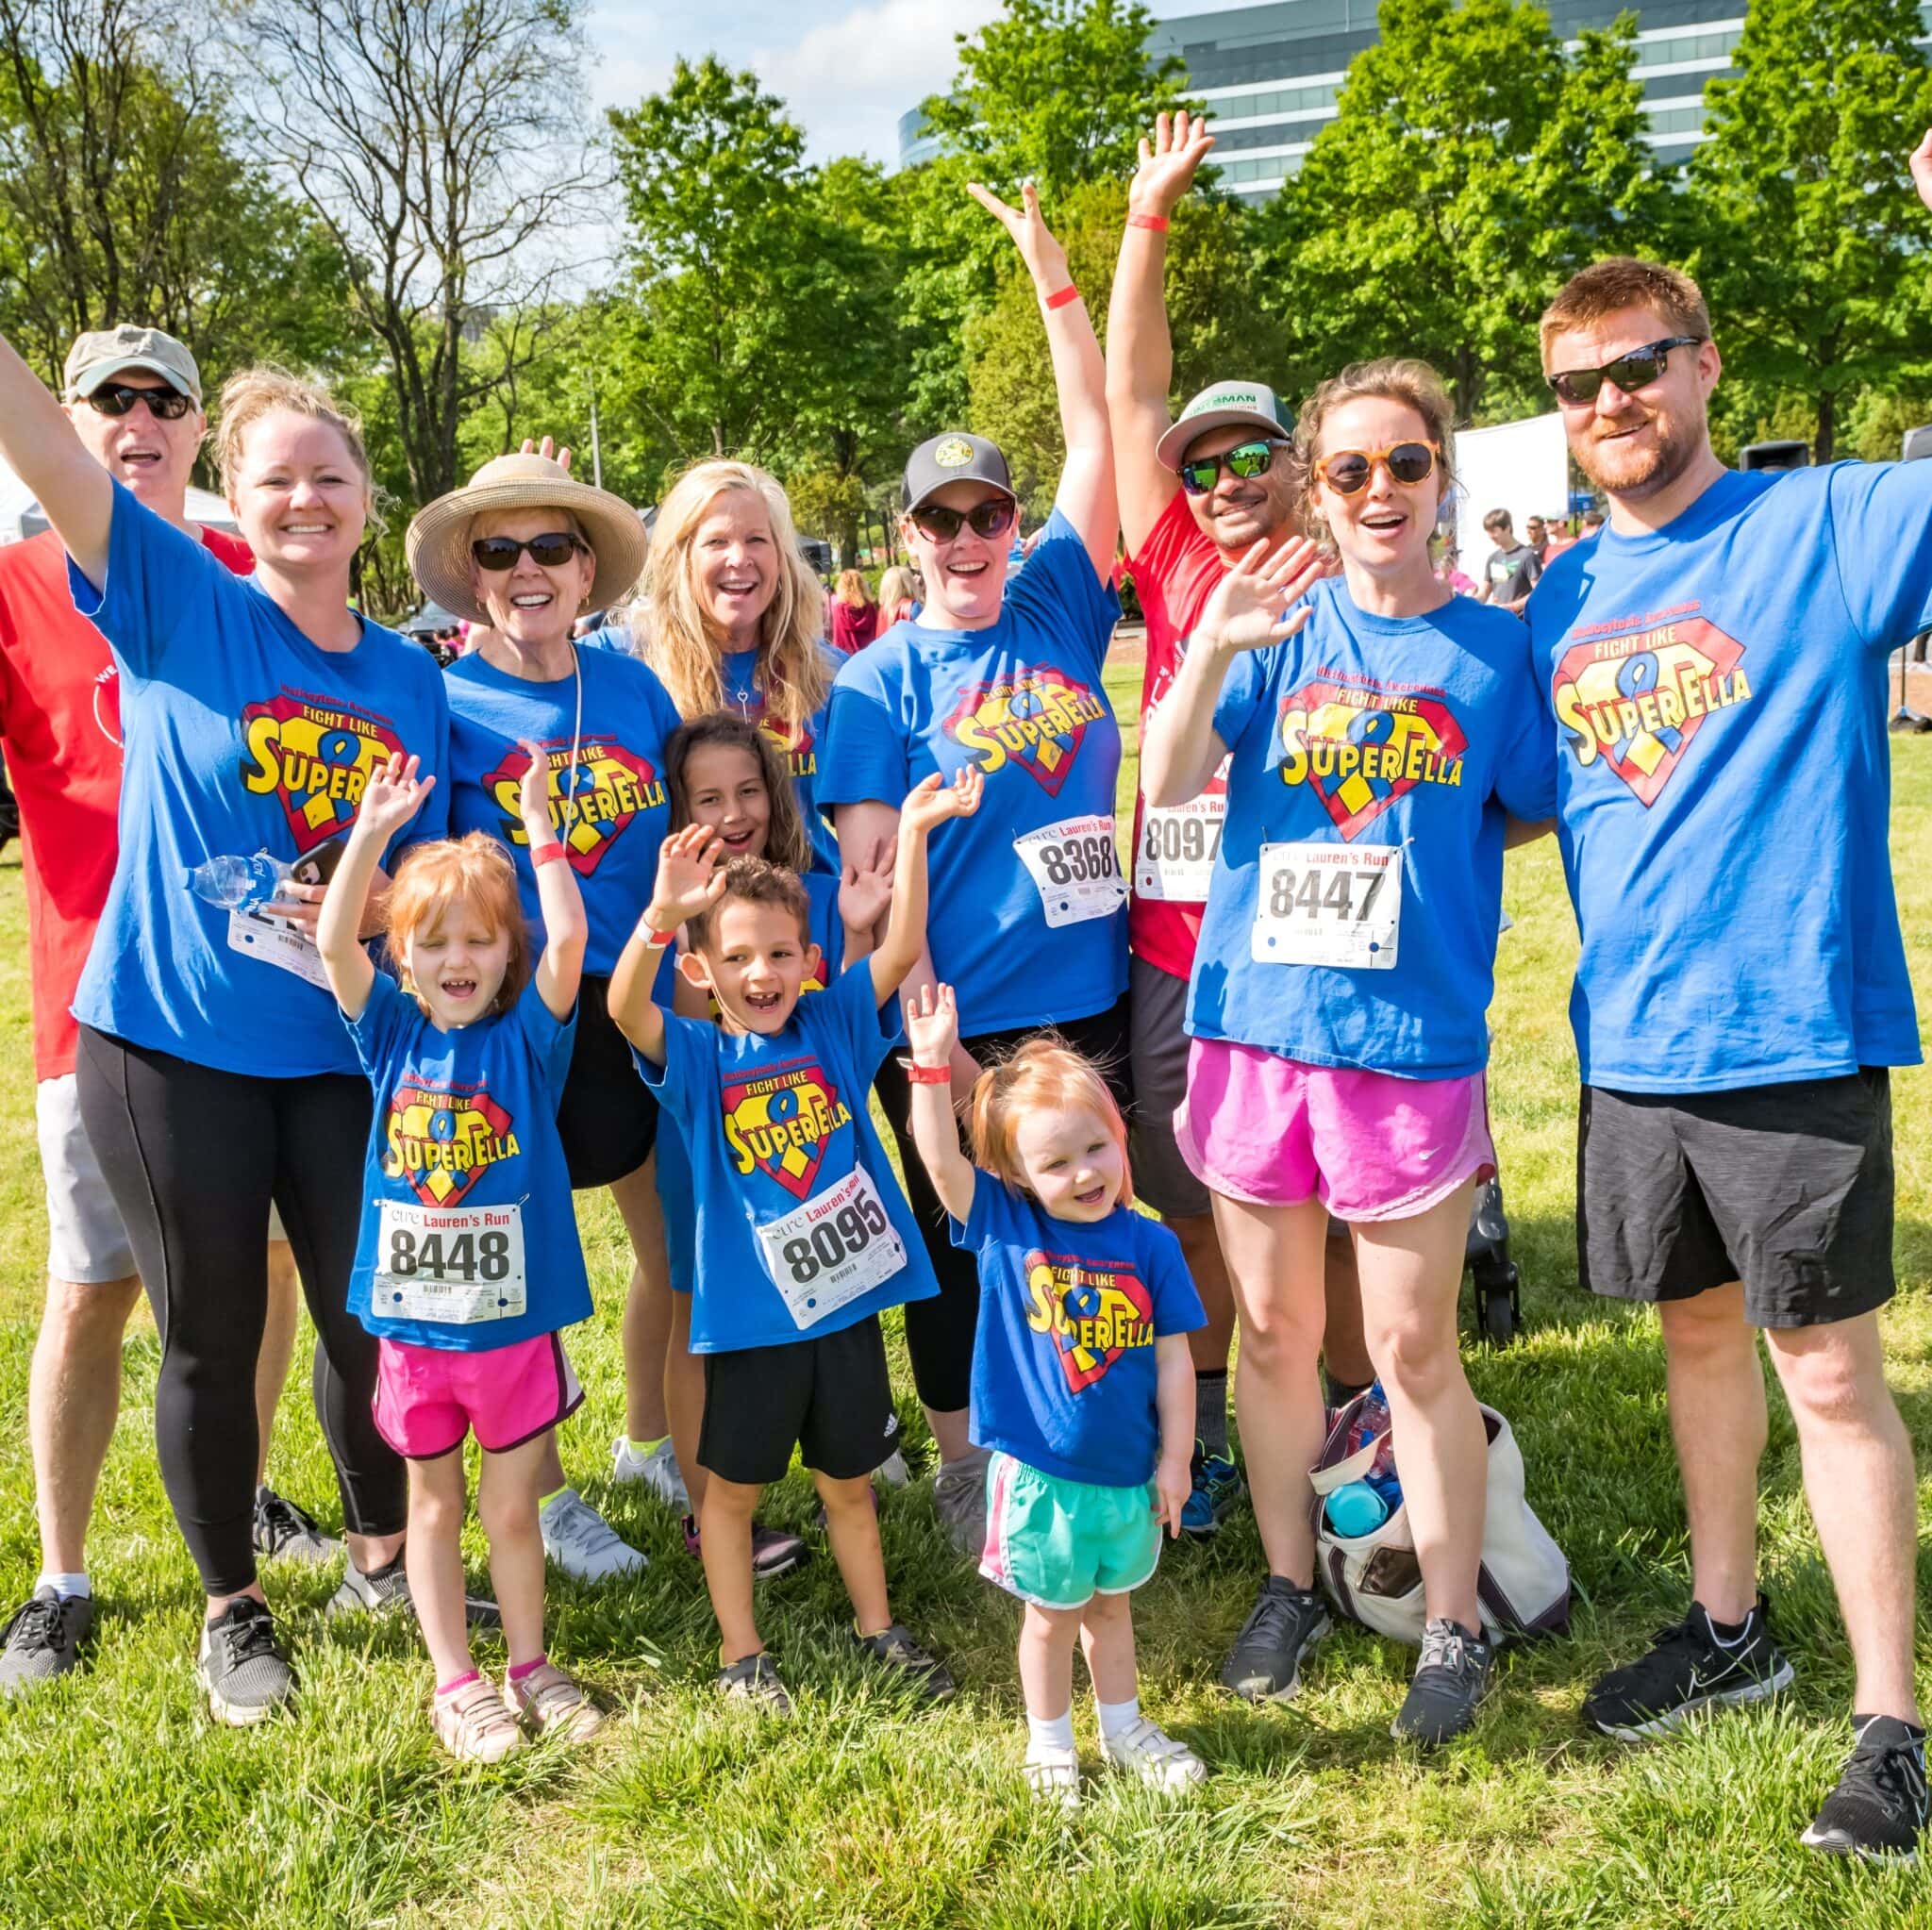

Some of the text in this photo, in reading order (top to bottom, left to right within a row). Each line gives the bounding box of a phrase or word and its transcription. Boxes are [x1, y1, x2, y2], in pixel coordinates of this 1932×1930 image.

[1594, 626, 1676, 658] FIGHT LIKE
[1337, 688, 1418, 712] FIGHT LIKE
[303, 705, 345, 728] FIGHT
[349, 718, 378, 738] LIKE
[576, 745, 607, 763] LIKE
[1059, 821, 1097, 837] Lauren's
[1099, 820, 1111, 830] Run
[1145, 818, 1224, 862] 8097
[1039, 836, 1112, 885] 8368
[1364, 852, 1389, 866] Run
[1270, 869, 1386, 922] 8447
[746, 1071, 808, 1095] FIGHT LIKE
[424, 1214, 480, 1228] Lauren's
[484, 1213, 510, 1225] Run
[806, 1188, 852, 1223] Lauren's
[783, 1188, 887, 1284] 8095
[391, 1229, 509, 1281] 8448
[1089, 1273, 1116, 1287] LIKE
